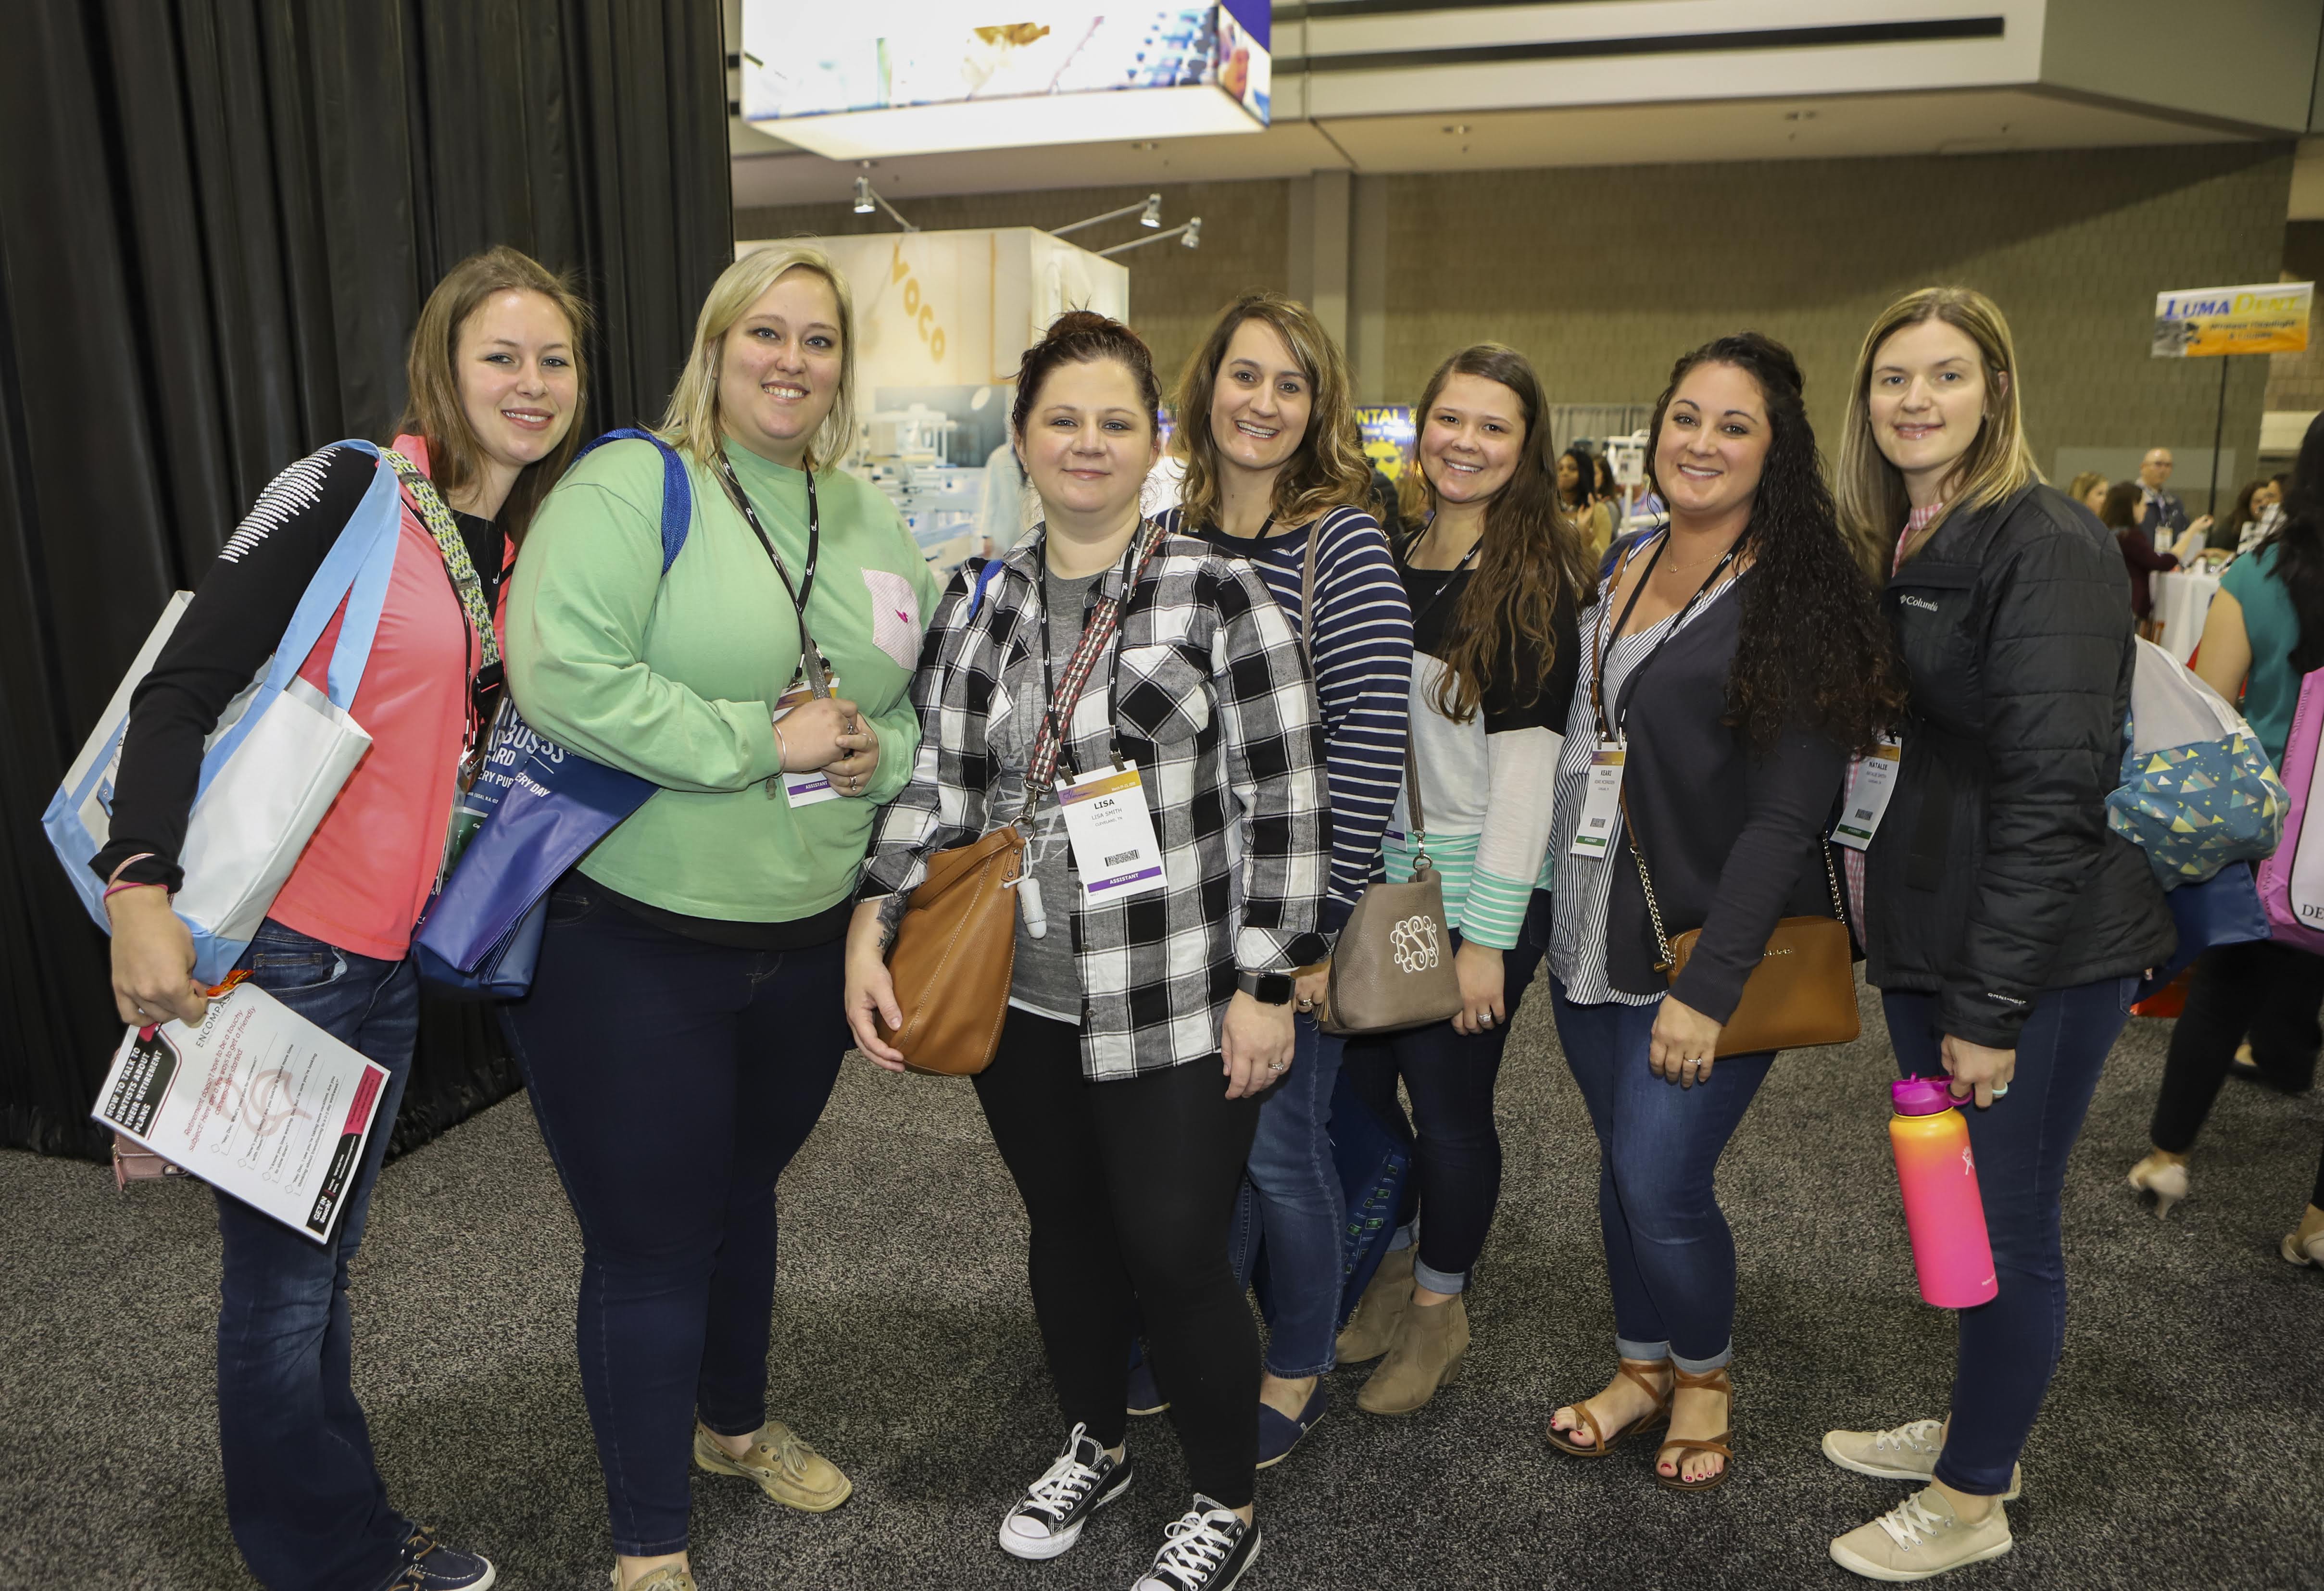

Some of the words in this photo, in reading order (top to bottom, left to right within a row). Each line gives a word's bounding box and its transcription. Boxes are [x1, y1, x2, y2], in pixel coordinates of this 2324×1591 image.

[892, 240, 946, 363] VOCO
[1869, 761, 1888, 770] NATALIE
[529, 783, 551, 798] DAY
[805, 781, 827, 789] ASSISTANT
[1094, 799, 1115, 809] LISA
[1105, 808, 1122, 817] SMITH
[1095, 819, 1117, 827] CLEVELAND,
[1110, 873, 1139, 884] ASSISTANT
[196, 991, 235, 1048] ENCOMPASS
[226, 1009, 243, 1034] touchy
[215, 1049, 223, 1057] to
[218, 1040, 227, 1050] be
[210, 1057, 220, 1073] have
[307, 1052, 317, 1069] looking
[106, 1094, 119, 1116] HOW
[114, 1081, 125, 1093] TO
[121, 1058, 136, 1080] TALK
[130, 1047, 140, 1058] TO
[115, 1081, 137, 1121] DENTISTS
[133, 1052, 150, 1081] ABOUT
[124, 1101, 140, 1126] THEIR
[136, 1050, 162, 1100] RETIREMENT
[188, 1123, 203, 1152] subject!
[200, 1105, 211, 1123] Here
[214, 1076, 223, 1086] few
[220, 1058, 229, 1075] ways
[225, 1050, 232, 1059] to
[229, 1038, 238, 1052] get
[237, 1005, 256, 1033] friendly
[201, 1073, 214, 1098] doesn't
[214, 1073, 233, 1115] conversation
[230, 1048, 242, 1073] started:
[269, 1083, 278, 1099] looking
[133, 1103, 151, 1132] PLANS
[184, 1097, 204, 1135] Retirement
[311, 1123, 319, 1137] taking
[297, 1168, 308, 1187] thinking
[311, 1127, 324, 1154] transitioning
[313, 1203, 323, 1220] GET
[319, 1195, 327, 1205] IN
[319, 1199, 332, 1223] touch!
